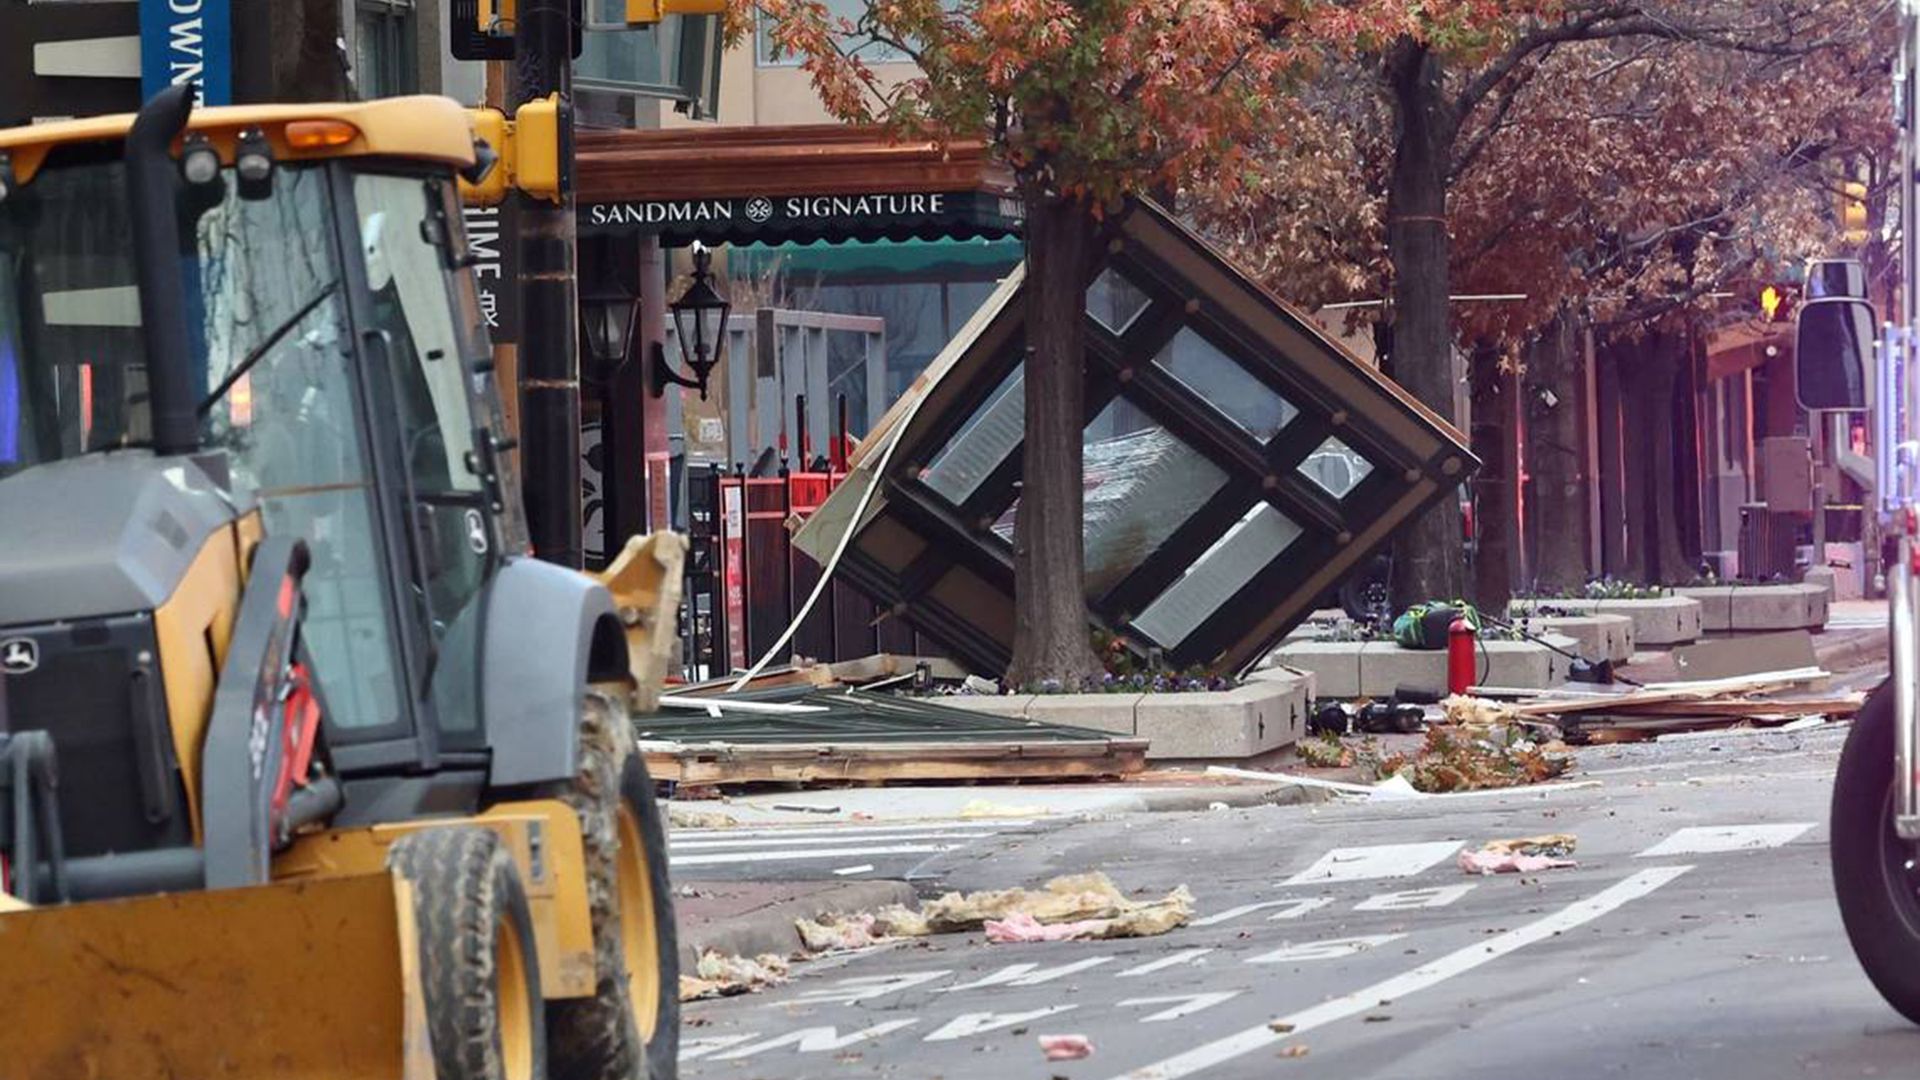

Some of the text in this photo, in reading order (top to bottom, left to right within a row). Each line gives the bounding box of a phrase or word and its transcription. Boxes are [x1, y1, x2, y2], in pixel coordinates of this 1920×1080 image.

[591, 193, 945, 225] SANDMAN SIGNATURE
[1189, 883, 1480, 926] BU
